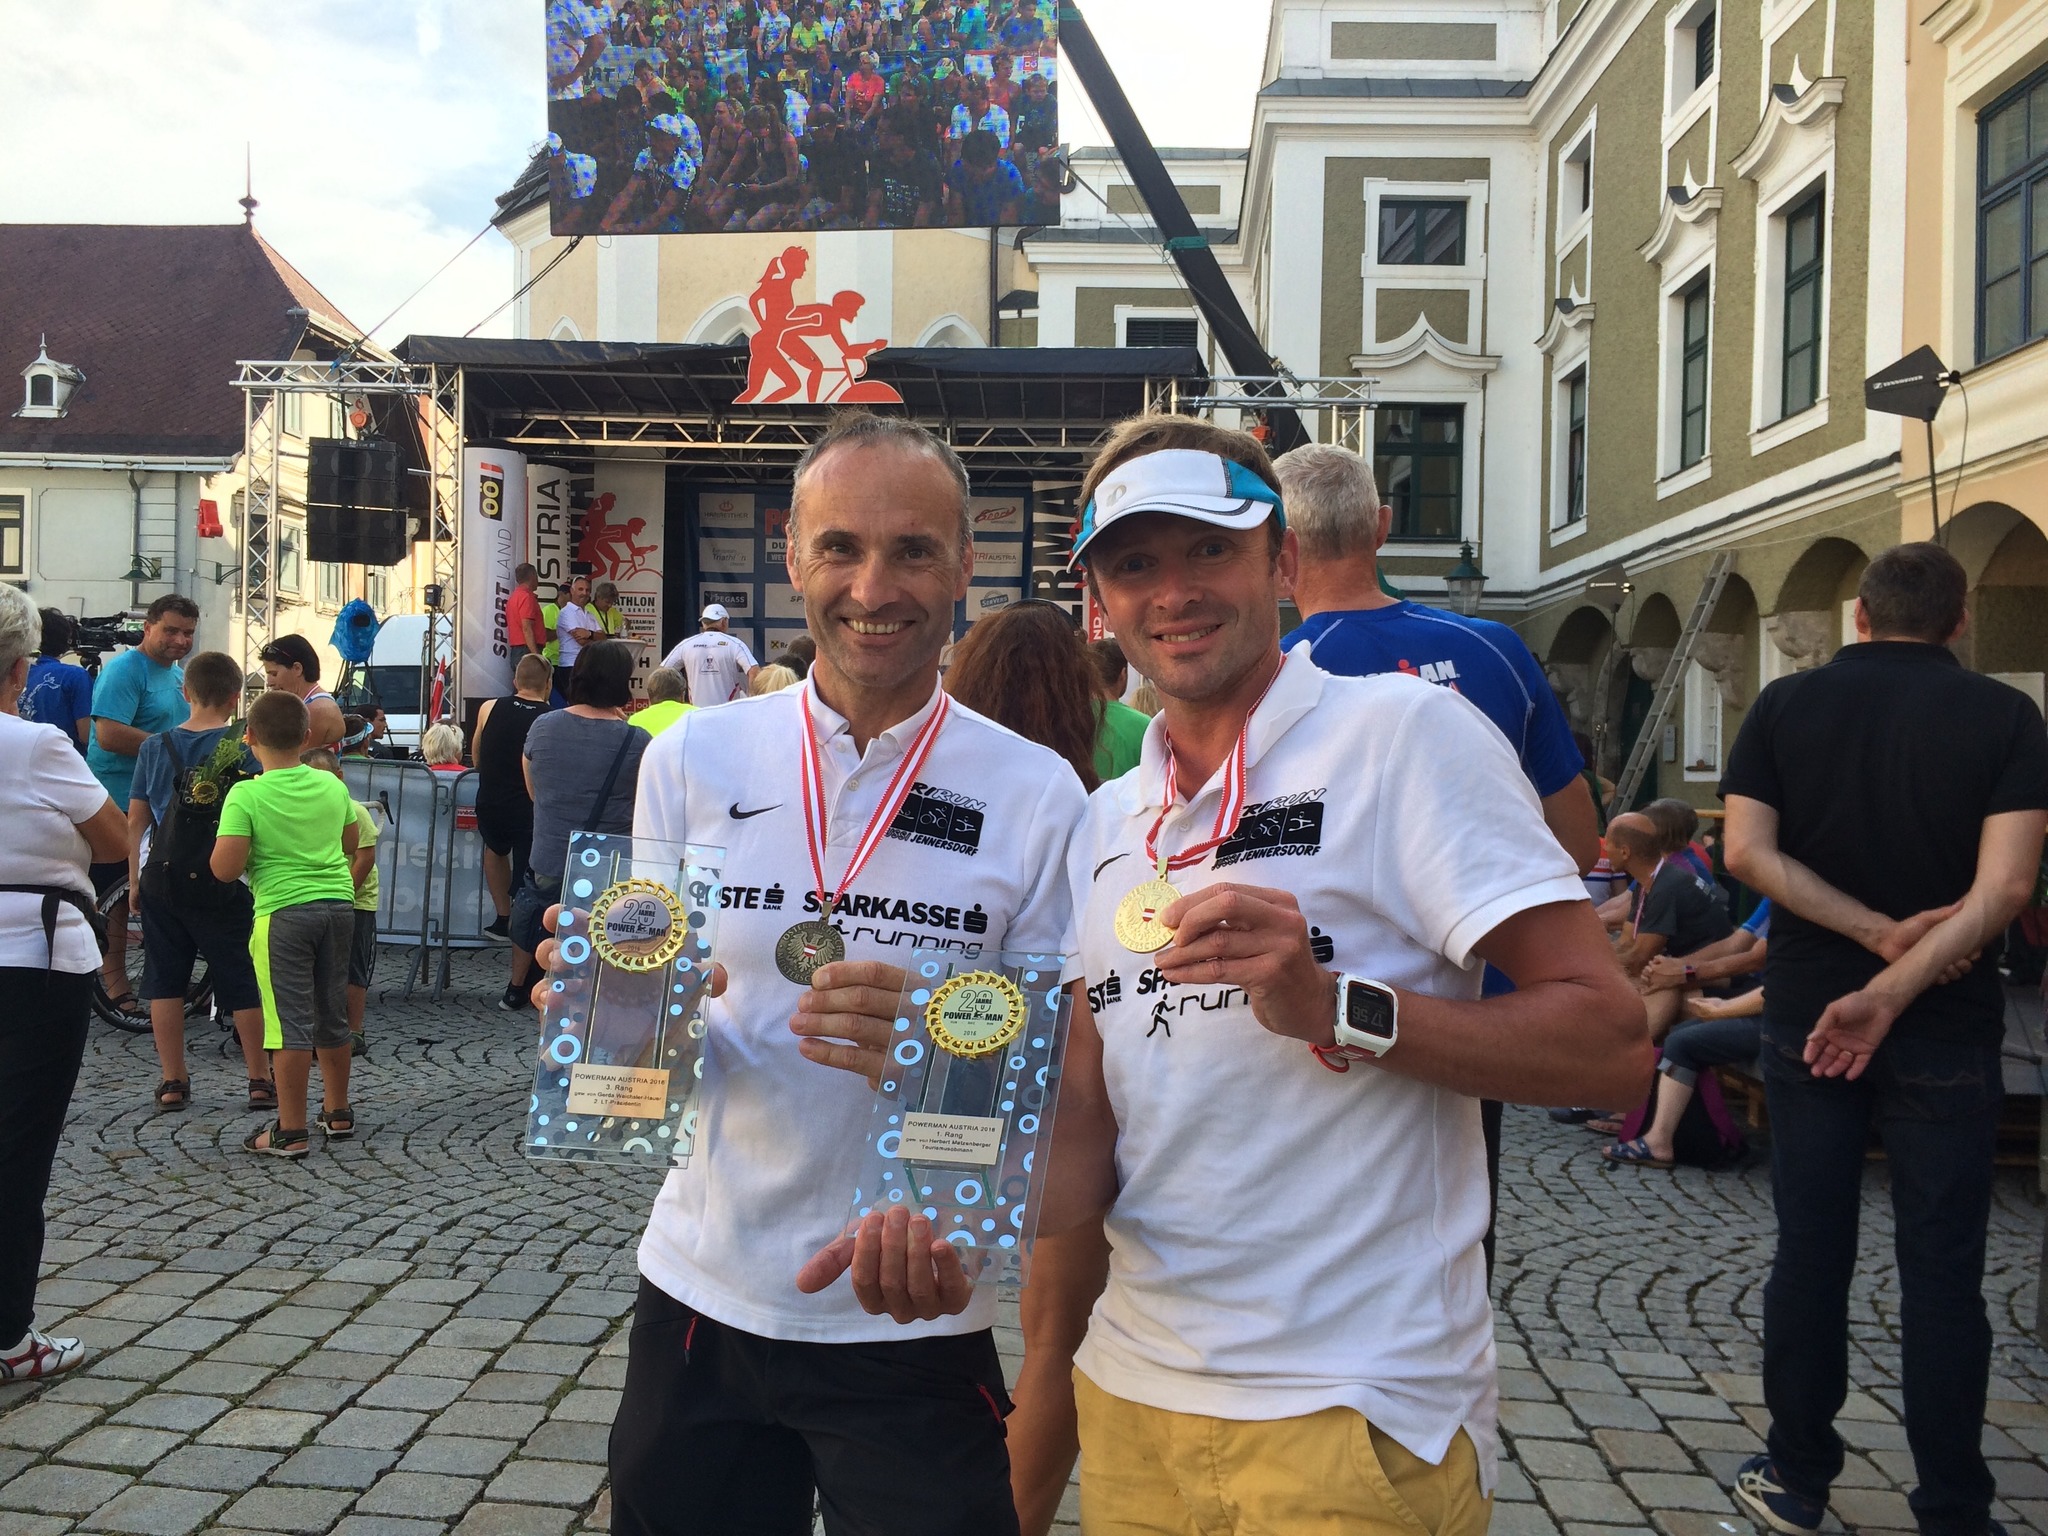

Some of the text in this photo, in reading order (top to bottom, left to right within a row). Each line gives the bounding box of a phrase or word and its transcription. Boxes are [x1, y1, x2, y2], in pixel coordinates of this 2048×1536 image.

[909, 834, 979, 857] JENNERSDORF
[1240, 845, 1322, 862] JENNERSDORF
[607, 922, 667, 937] POWER MAN
[853, 927, 984, 960] running
[943, 1011, 1004, 1022] POWER MAN
[574, 1073, 617, 1081] POWERMAN
[617, 1076, 648, 1084] AUSTRIA
[614, 1084, 633, 1093] Rang
[907, 1120, 948, 1129] POWERMAN
[944, 1131, 963, 1139] Rang
